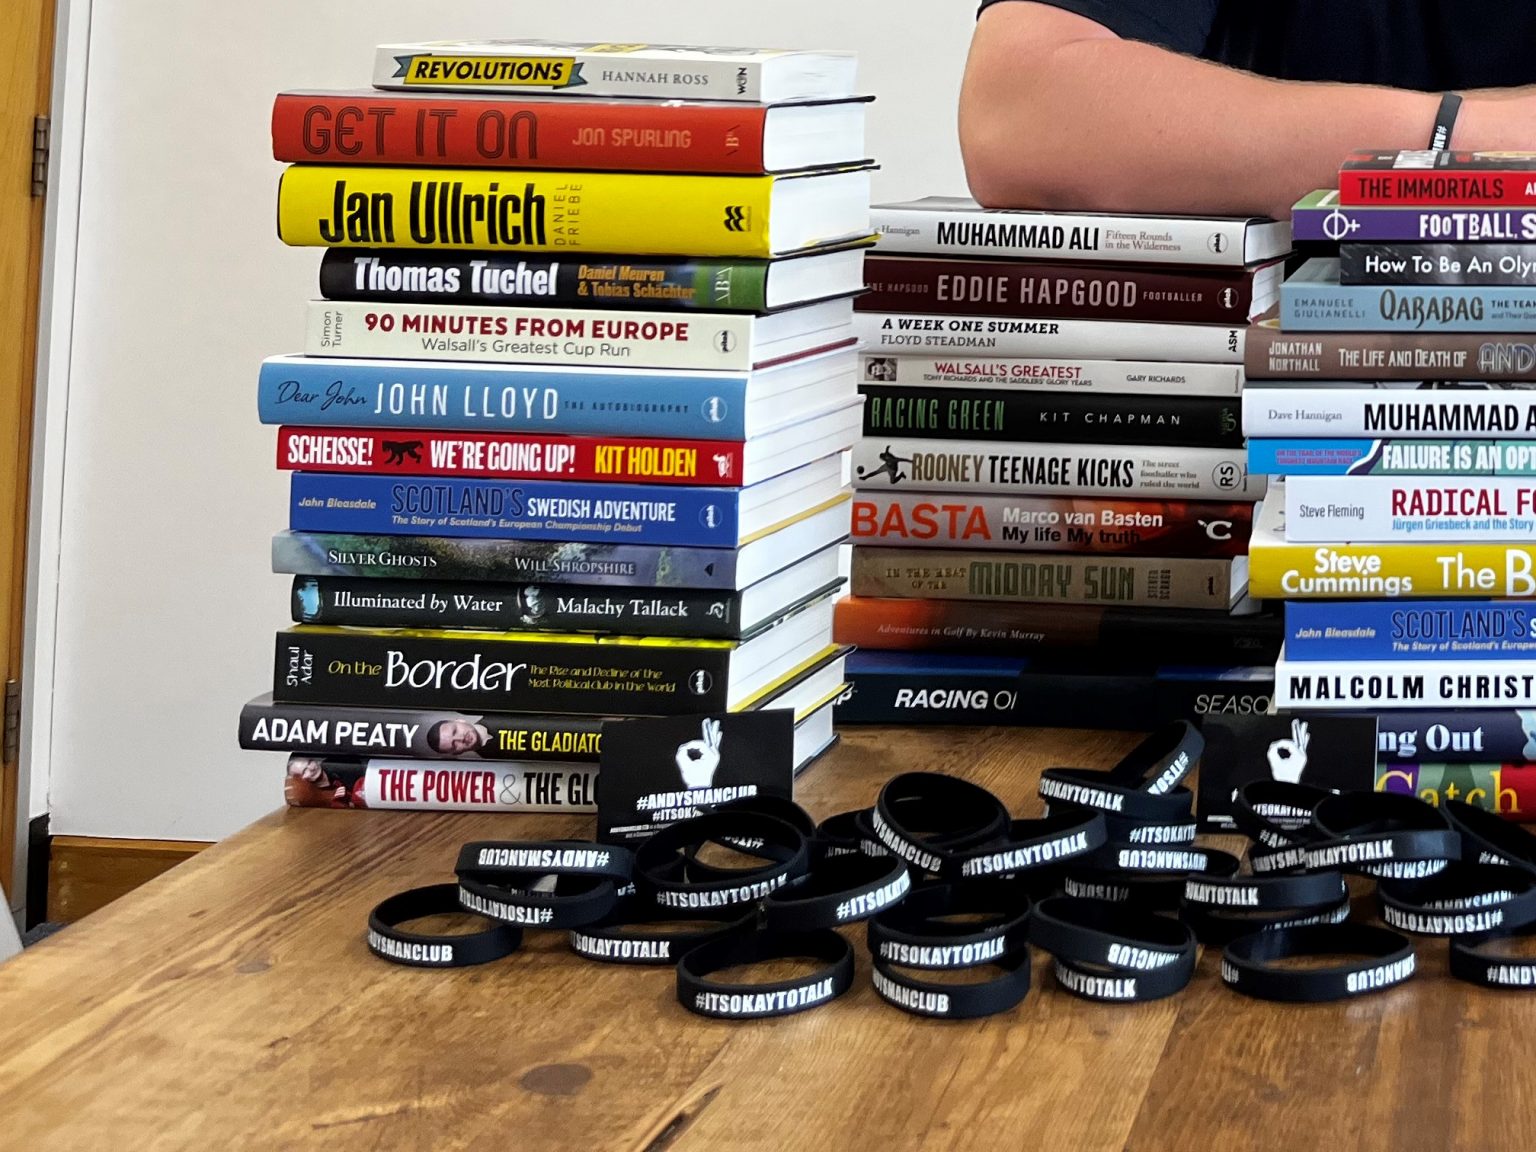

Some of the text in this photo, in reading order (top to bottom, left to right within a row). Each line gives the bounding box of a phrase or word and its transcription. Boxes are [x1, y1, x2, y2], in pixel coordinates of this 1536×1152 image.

[414, 60, 709, 86] REVOLUTIONS HANNAH ROSS
[302, 104, 691, 160] GET IT ON JON SPURLING
[1358, 179, 1392, 198] THE
[1399, 179, 1503, 198] IMMORTALS
[319, 180, 547, 246] Jan Ullrich
[555, 184, 566, 245] DANIEL
[569, 184, 582, 245] FRIEBE
[937, 222, 1098, 251] MUHAMMAD ALI
[353, 259, 557, 296] Thomas Tuchel
[1365, 256, 1404, 273] How
[1410, 256, 1433, 273] To
[1440, 257, 1461, 273] Be
[1468, 257, 1492, 273] An
[937, 275, 1137, 307] EDDIE HAPGOOD
[320, 312, 331, 348] Simon
[332, 311, 343, 348] Turner
[365, 313, 689, 342] 90 MINUTES FROM EUROPE
[881, 335, 996, 348] FLOYD STEADMAN
[882, 319, 1059, 335] A WEEK ONE SUMMER
[935, 362, 1082, 379] WALSALL'S GREATEST
[374, 384, 558, 420] JOHN LLOYD
[871, 397, 1181, 431] RACING GREEN KIT CHAPMAN
[1268, 410, 1342, 423] Dave Hannigan
[287, 435, 696, 477] SCHEISSE! WE'RE GOING UP! KIT HOLDEN
[912, 453, 1134, 487] ROONEY TEENAGE KICKS
[1383, 447, 1450, 469] FAILURE
[1454, 447, 1471, 469] IS
[1475, 447, 1498, 469] AN
[528, 496, 675, 522] SWEDISH ADVENTURE
[1003, 508, 1163, 527] Marco van Basten
[1300, 504, 1330, 517] Steve
[1333, 504, 1364, 519] Fleming
[1392, 488, 1507, 517] RADICAL
[851, 502, 992, 539] BASTA
[1314, 549, 1381, 572] Steve
[1437, 553, 1496, 589] The
[1281, 571, 1412, 595] Cummings
[334, 591, 688, 619] Illuminated by Water Malachy Tallack
[329, 651, 526, 692] On the Border
[895, 690, 988, 709] RACING
[1290, 675, 1424, 699] MALCOLM
[252, 719, 420, 748] ADAM PEATY
[378, 768, 496, 804] THE POWER
[478, 848, 609, 867] #ANDYSMANCLUB
[962, 831, 1088, 876] #ITSOKAYTOTALK
[1384, 905, 1503, 933] #ITSOKAYTOTALK
[880, 936, 1005, 965] #ITSOKAYTOTALK
[695, 977, 833, 1012] #ITSOKAYTOTALK
